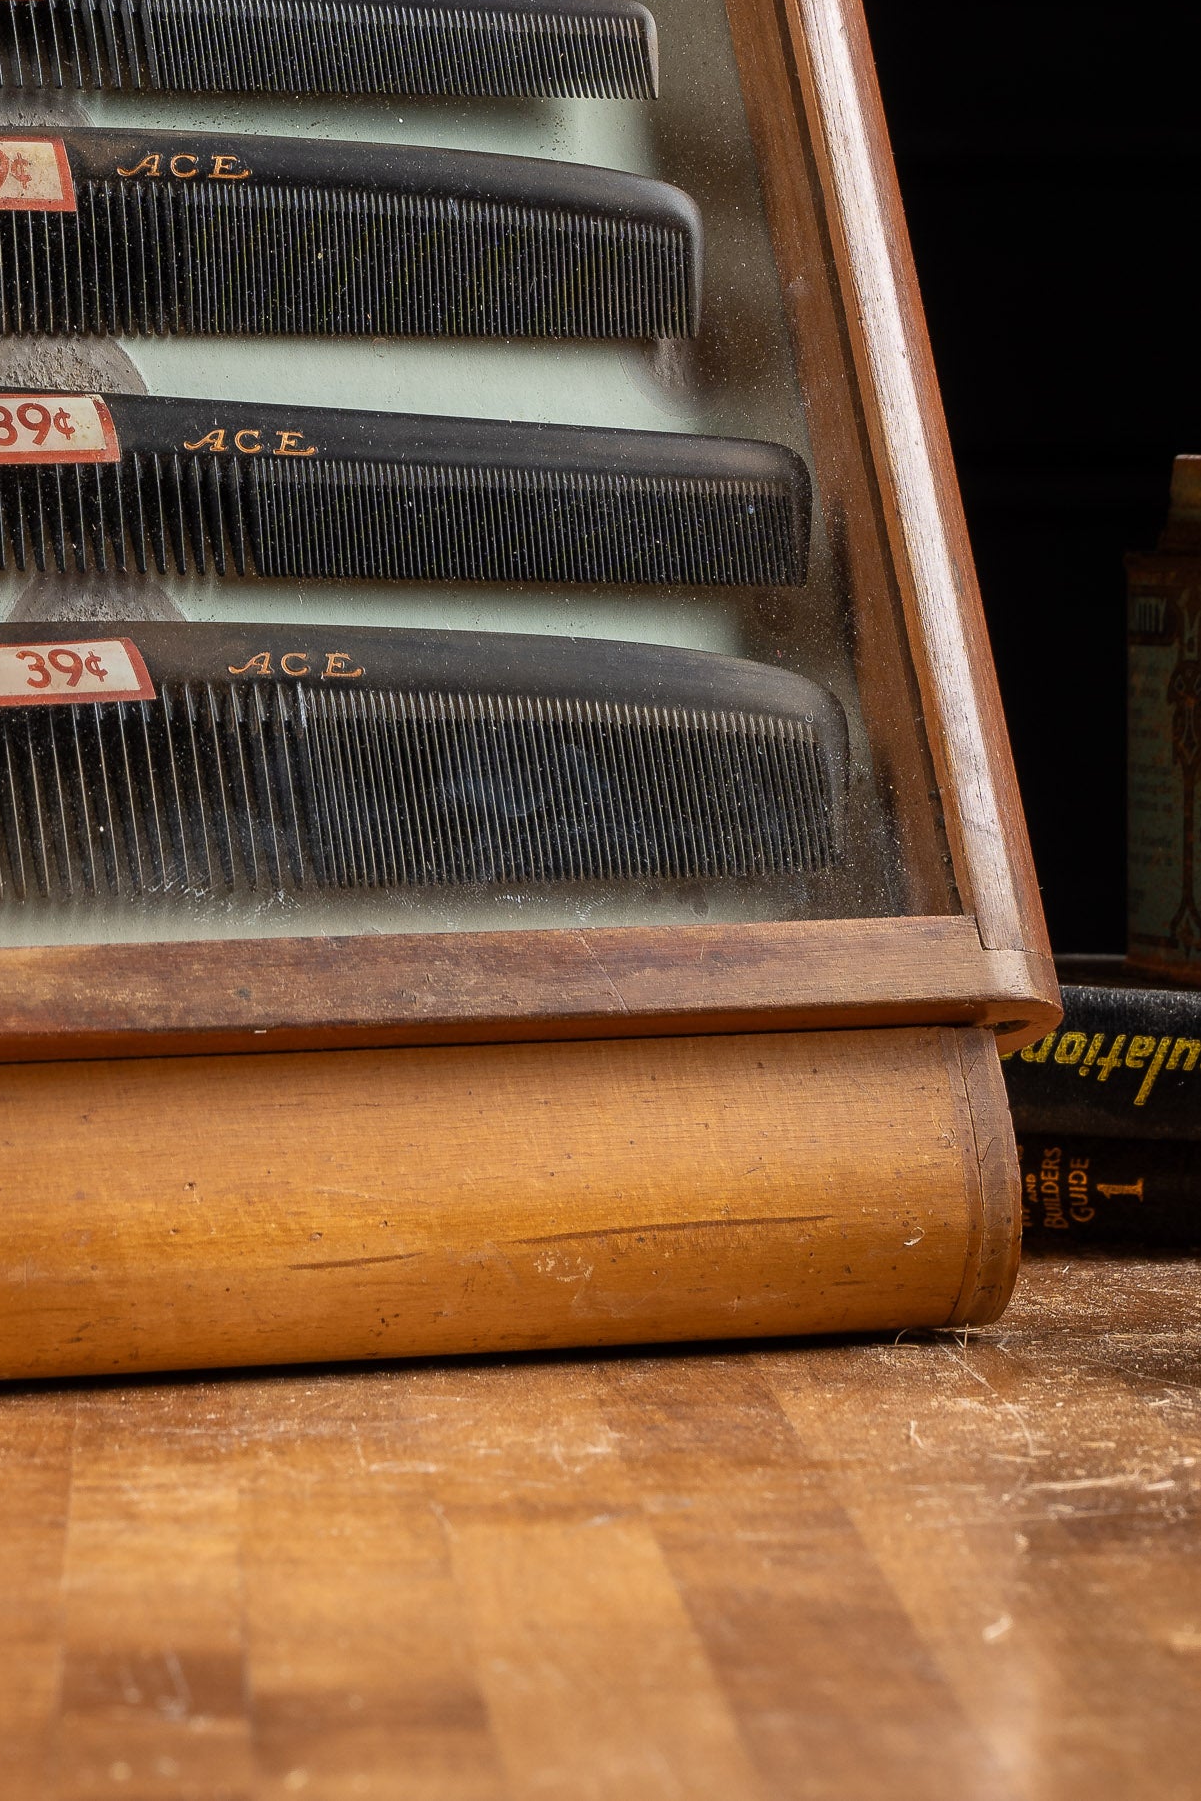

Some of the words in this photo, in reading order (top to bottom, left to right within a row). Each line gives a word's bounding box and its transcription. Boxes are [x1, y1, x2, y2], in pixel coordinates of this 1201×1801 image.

[116, 153, 253, 180] ACE
[183, 428, 318, 457] ACE
[15, 648, 109, 690] 39¢
[228, 651, 364, 678] ACE
[999, 1030, 1201, 1106] ulation
[1025, 1173, 1039, 1204] AND
[1040, 1146, 1069, 1230] BUILDERS
[1067, 1157, 1096, 1223] GUIDE
[1096, 1176, 1145, 1204] 1
